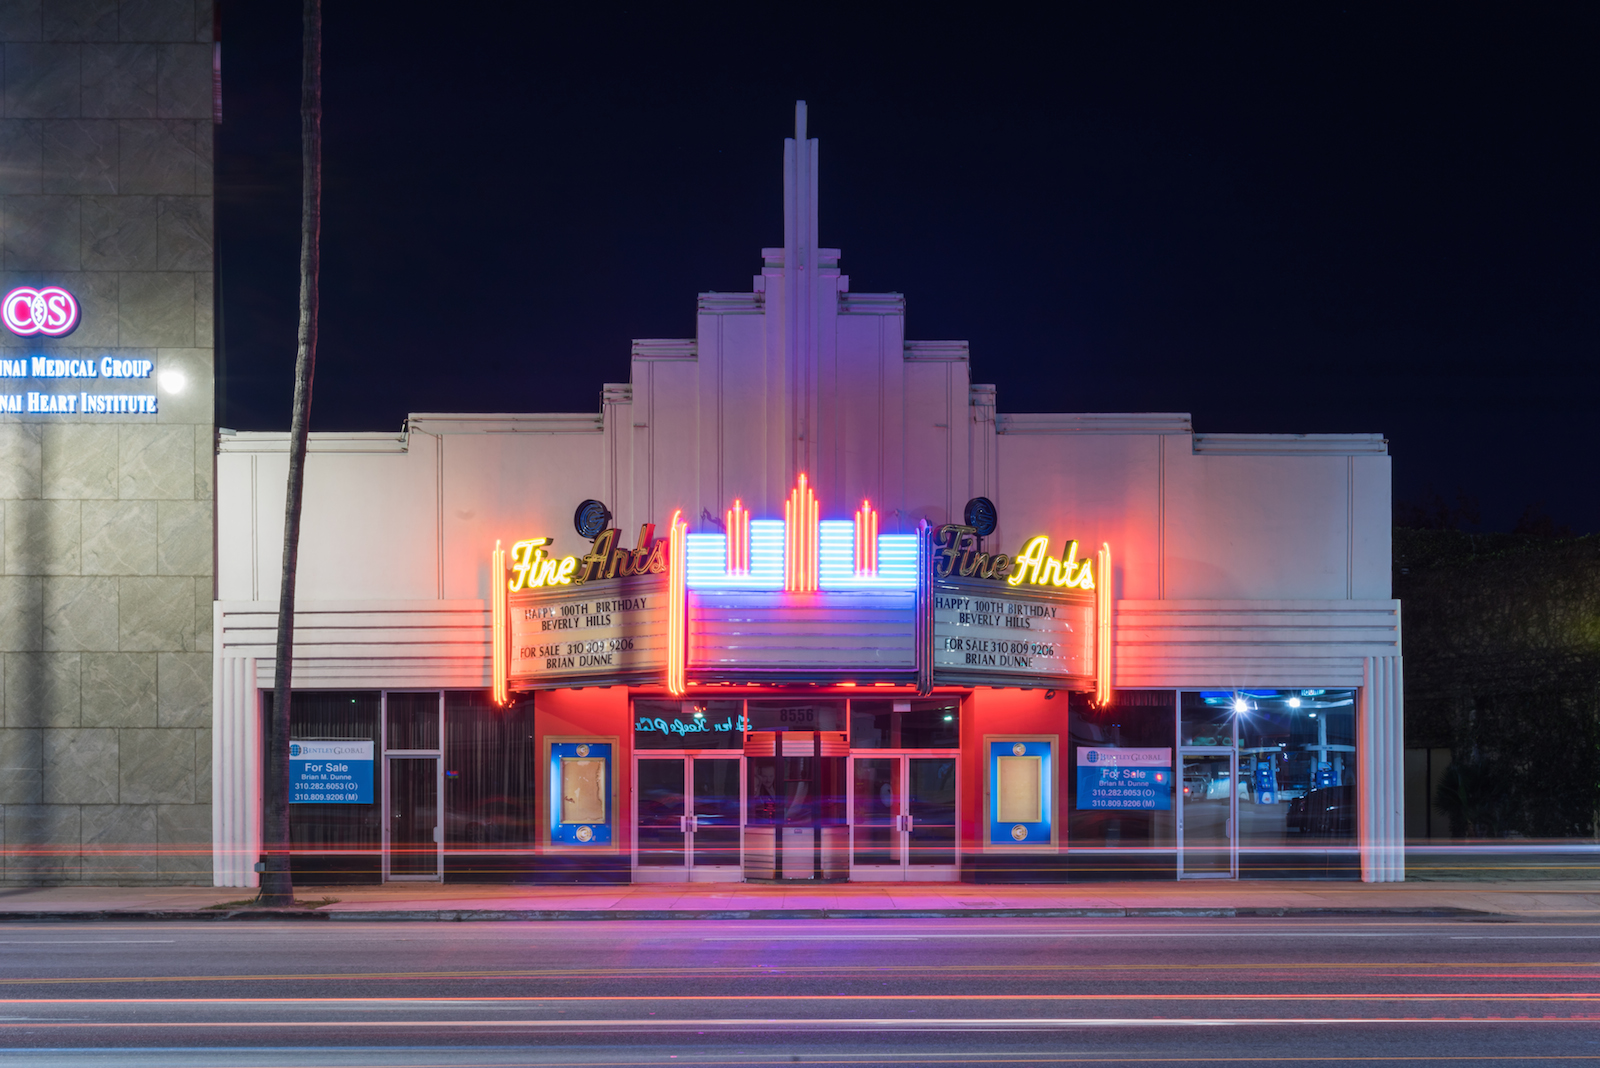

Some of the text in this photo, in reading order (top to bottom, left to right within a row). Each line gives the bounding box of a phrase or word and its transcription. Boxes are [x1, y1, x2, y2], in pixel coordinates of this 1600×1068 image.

[508, 523, 670, 593] Fine Arts
[933, 523, 1096, 590] Fine Arts
[524, 598, 647, 619] HAPPY 100TH BIRTHDAY
[936, 597, 1057, 618] HAPPY 100TH BIRTHDAY
[541, 615, 612, 631] BEVERLY HILLS
[959, 612, 1031, 629] BEVERLY HILLS
[520, 647, 537, 658] FOR
[539, 645, 560, 657] SALE
[567, 643, 584, 655] 310
[609, 638, 634, 651] 9206
[944, 637, 1054, 656] FOR SALE 310 809 9206
[546, 654, 613, 669] BRIAN DUNNE
[965, 652, 1033, 668] BRIAN DUNNE
[780, 708, 815, 723] 8556
[304, 762, 349, 772] For Sale
[1102, 770, 1146, 778] For Sale
